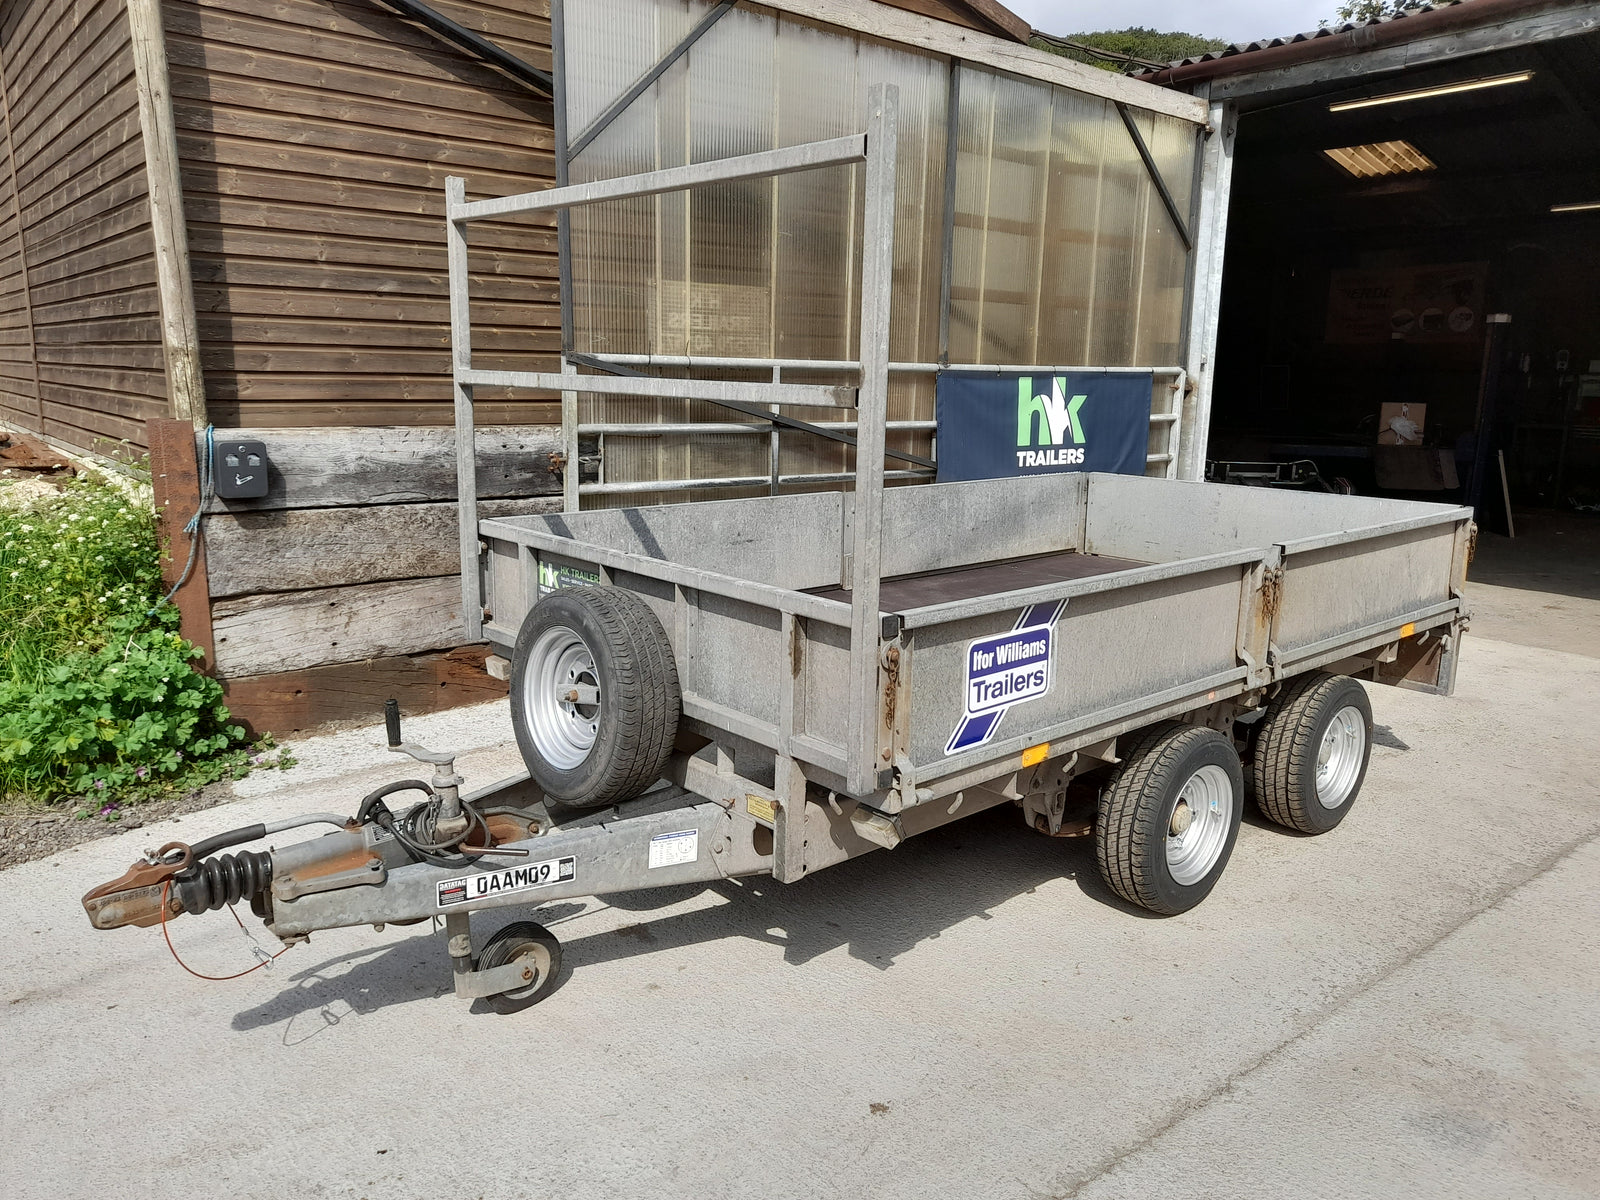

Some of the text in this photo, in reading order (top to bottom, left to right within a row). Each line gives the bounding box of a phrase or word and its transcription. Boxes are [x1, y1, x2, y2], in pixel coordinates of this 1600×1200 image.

[1016, 448, 1085, 468] TRAILERS
[560, 565, 570, 576] HK
[973, 639, 1046, 672] Ifor Williams
[973, 669, 1045, 703] Trailers
